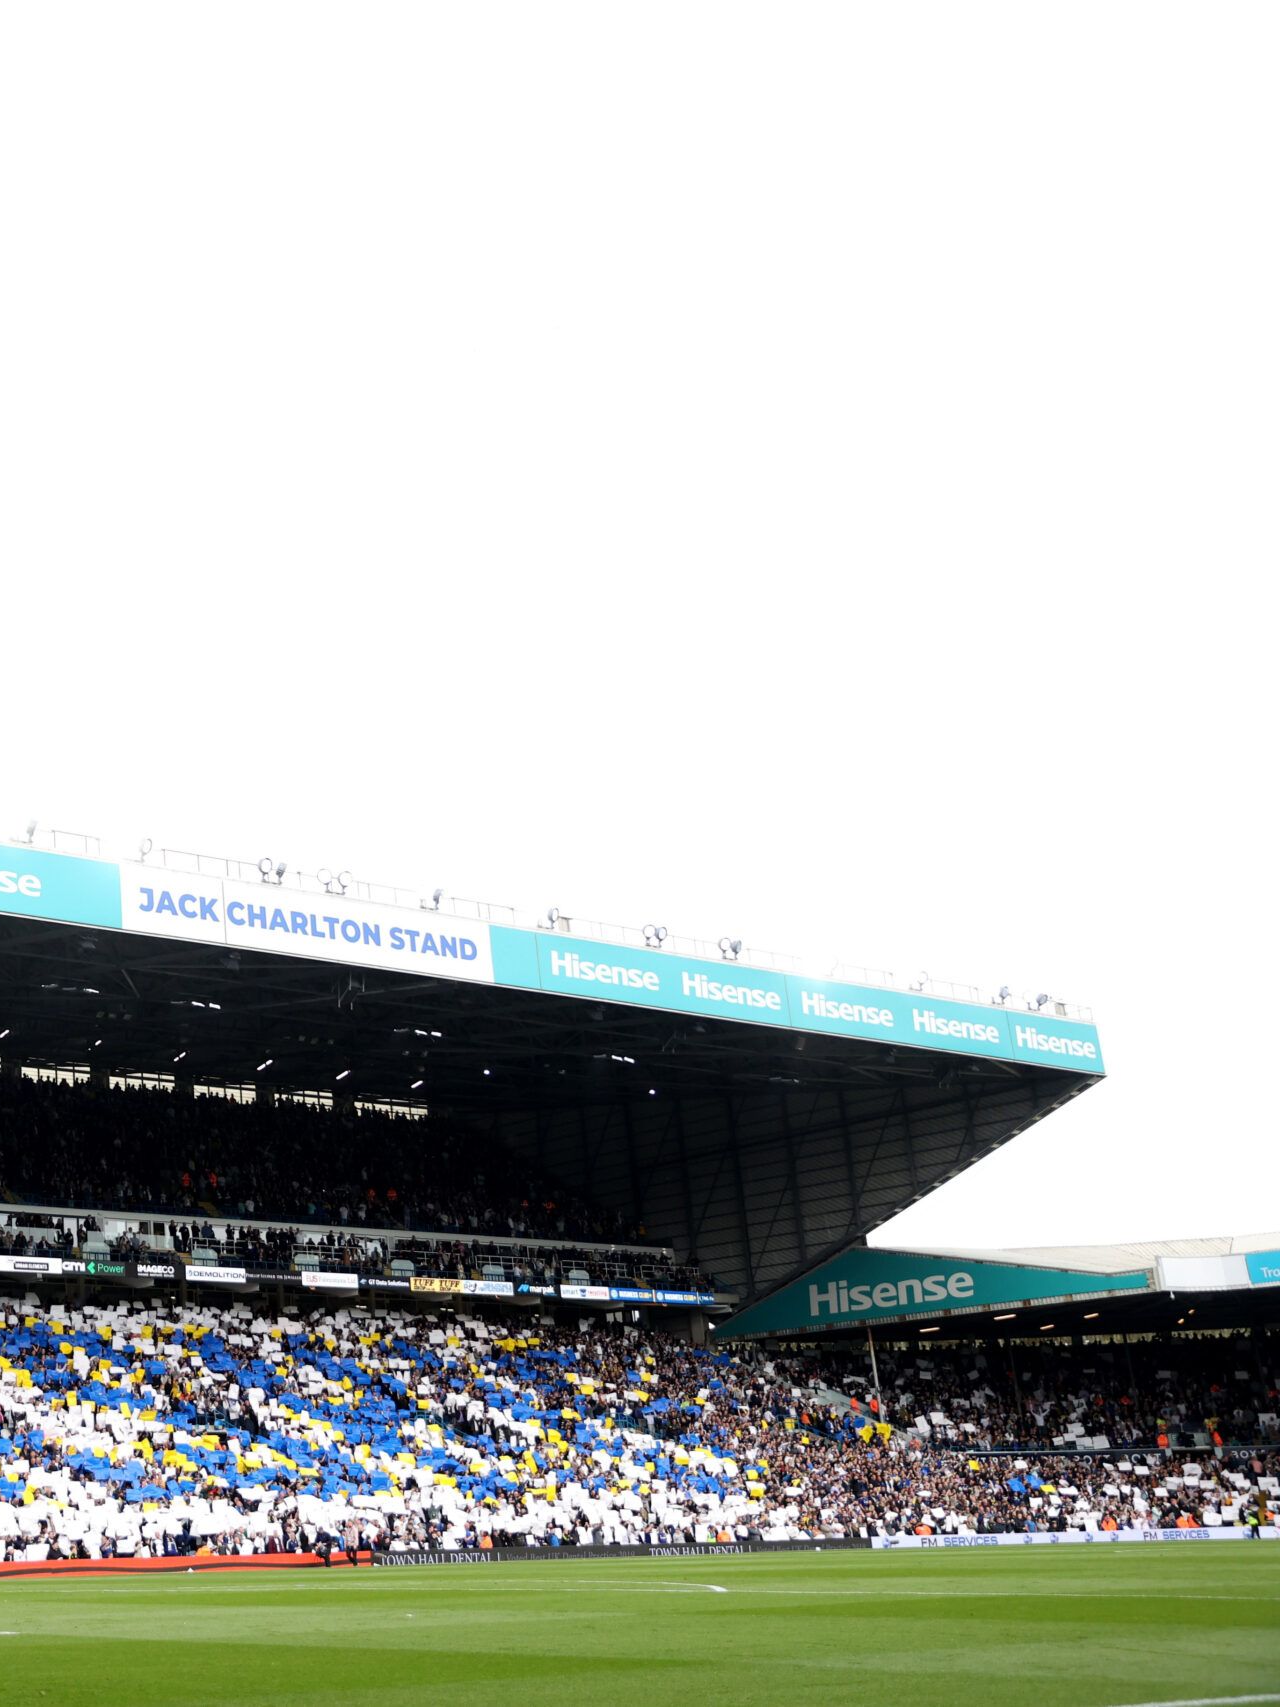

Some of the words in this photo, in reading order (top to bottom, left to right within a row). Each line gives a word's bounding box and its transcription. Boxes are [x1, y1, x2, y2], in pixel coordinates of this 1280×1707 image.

[139, 886, 220, 922] JACK
[226, 901, 381, 946] CHARLTON
[390, 927, 478, 961] STAND
[550, 950, 659, 991] Hisense
[681, 971, 781, 1011] Hisense
[801, 991, 893, 1028] Hisense
[913, 1008, 999, 1044] Hisense
[1015, 1024, 1096, 1059] Hisense
[97, 1262, 124, 1274] Power
[193, 1270, 245, 1280] DEMOLITION
[413, 1278, 435, 1287] TUFF
[439, 1279, 460, 1288] TUFF
[529, 1285, 555, 1294] marpak
[809, 1271, 974, 1316] Hisense
[920, 1537, 938, 1547] FM
[943, 1535, 998, 1546] SERVICES
[1143, 1531, 1157, 1541] FM
[1162, 1529, 1210, 1540] SERVICES
[649, 1547, 680, 1557] TOWN
[682, 1545, 705, 1555] HALL
[708, 1544, 744, 1554] DENTAL
[381, 1554, 416, 1566] TOWN
[418, 1553, 446, 1565] HALL
[450, 1552, 491, 1564] DENTAL
